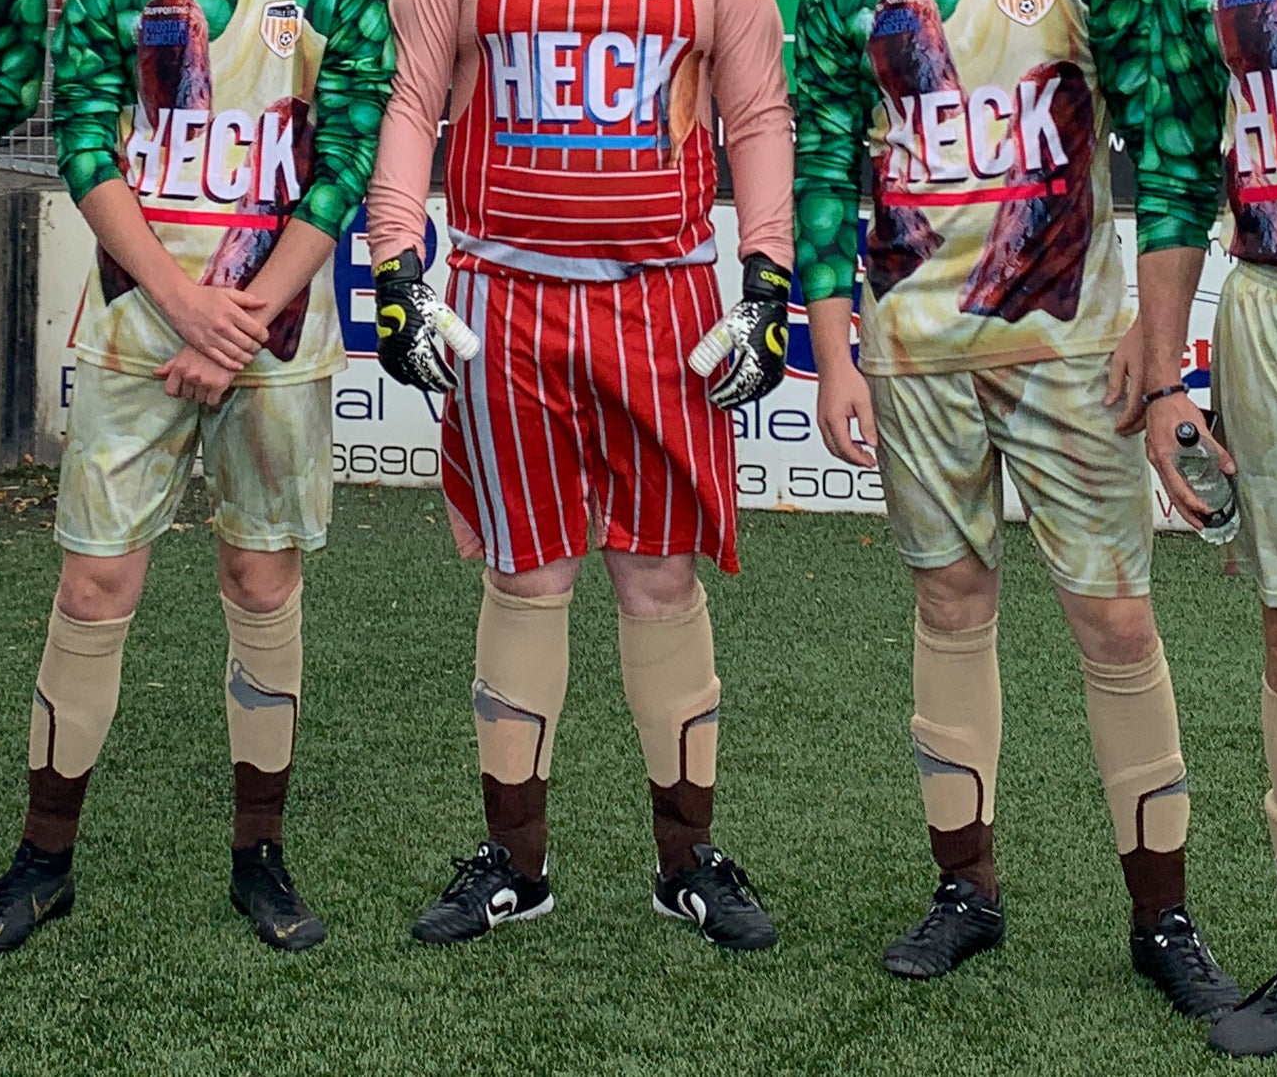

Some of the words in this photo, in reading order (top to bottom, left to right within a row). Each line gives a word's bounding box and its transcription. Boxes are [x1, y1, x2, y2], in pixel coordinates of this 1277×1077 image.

[484, 31, 690, 125] HECK
[126, 107, 302, 203] HECK
[884, 77, 1070, 182] HECK
